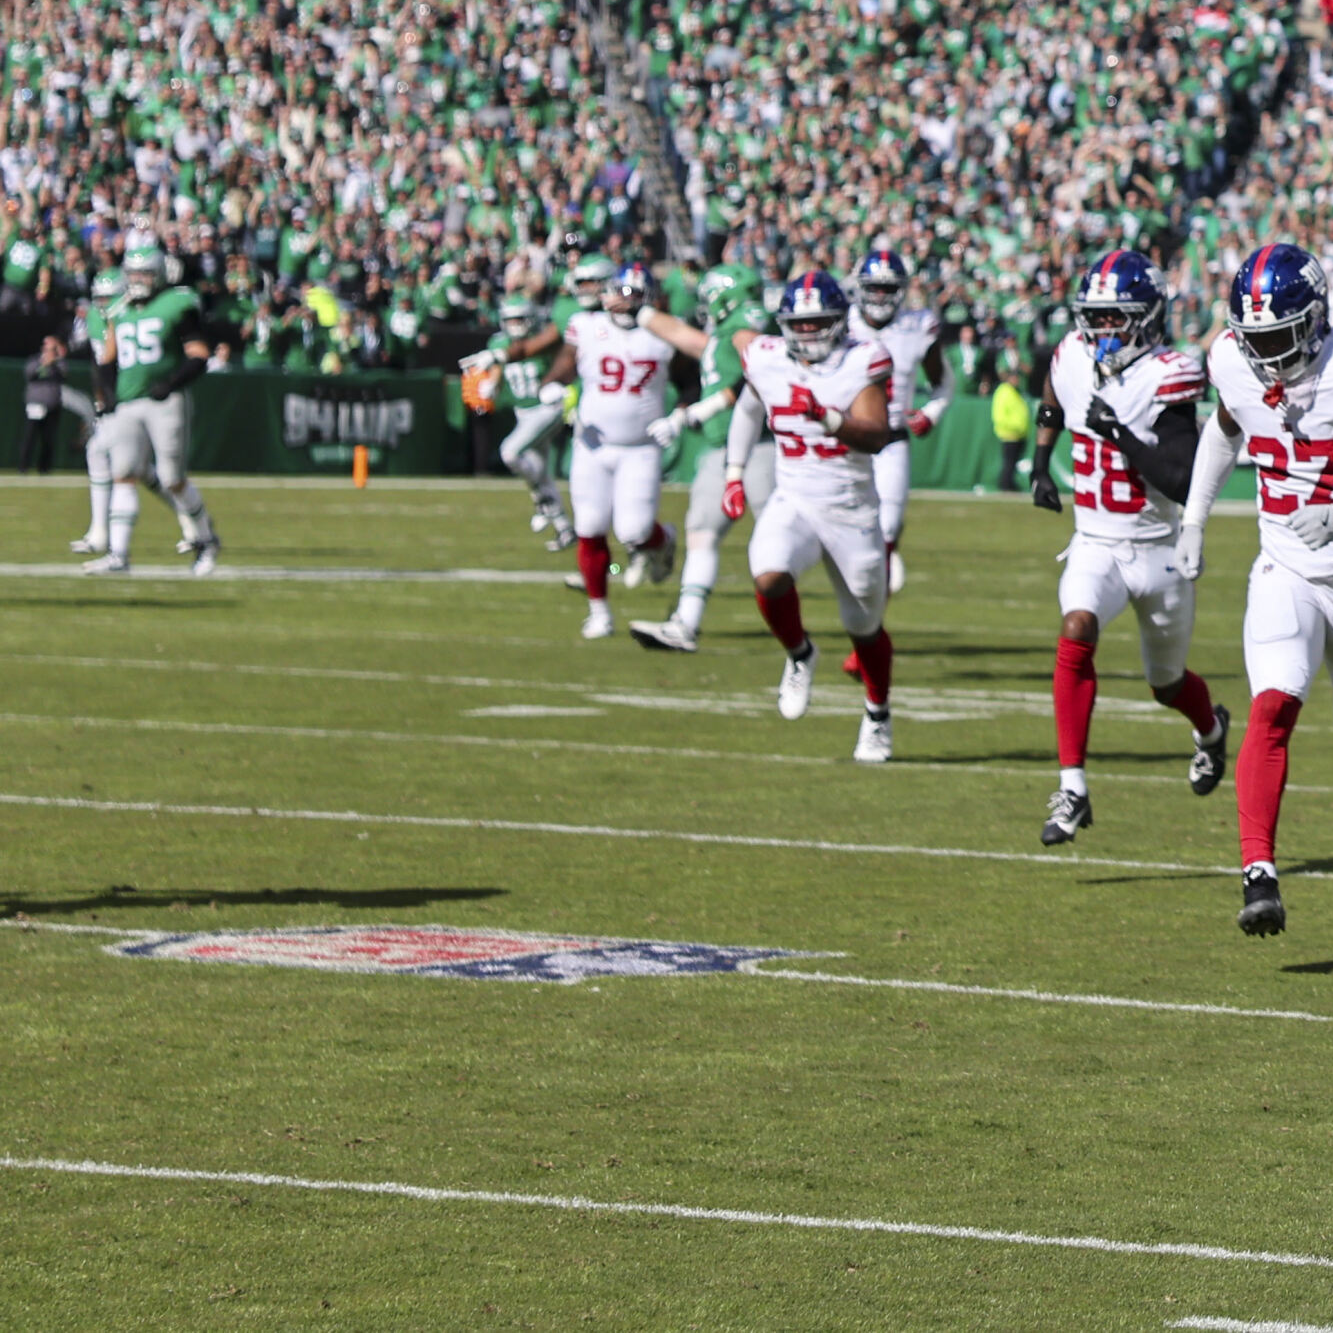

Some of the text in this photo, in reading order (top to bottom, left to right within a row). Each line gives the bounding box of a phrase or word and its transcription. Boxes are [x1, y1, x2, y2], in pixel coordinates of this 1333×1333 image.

[114, 316, 164, 369] 65
[599, 357, 658, 395] 97
[1072, 432, 1147, 514] 28
